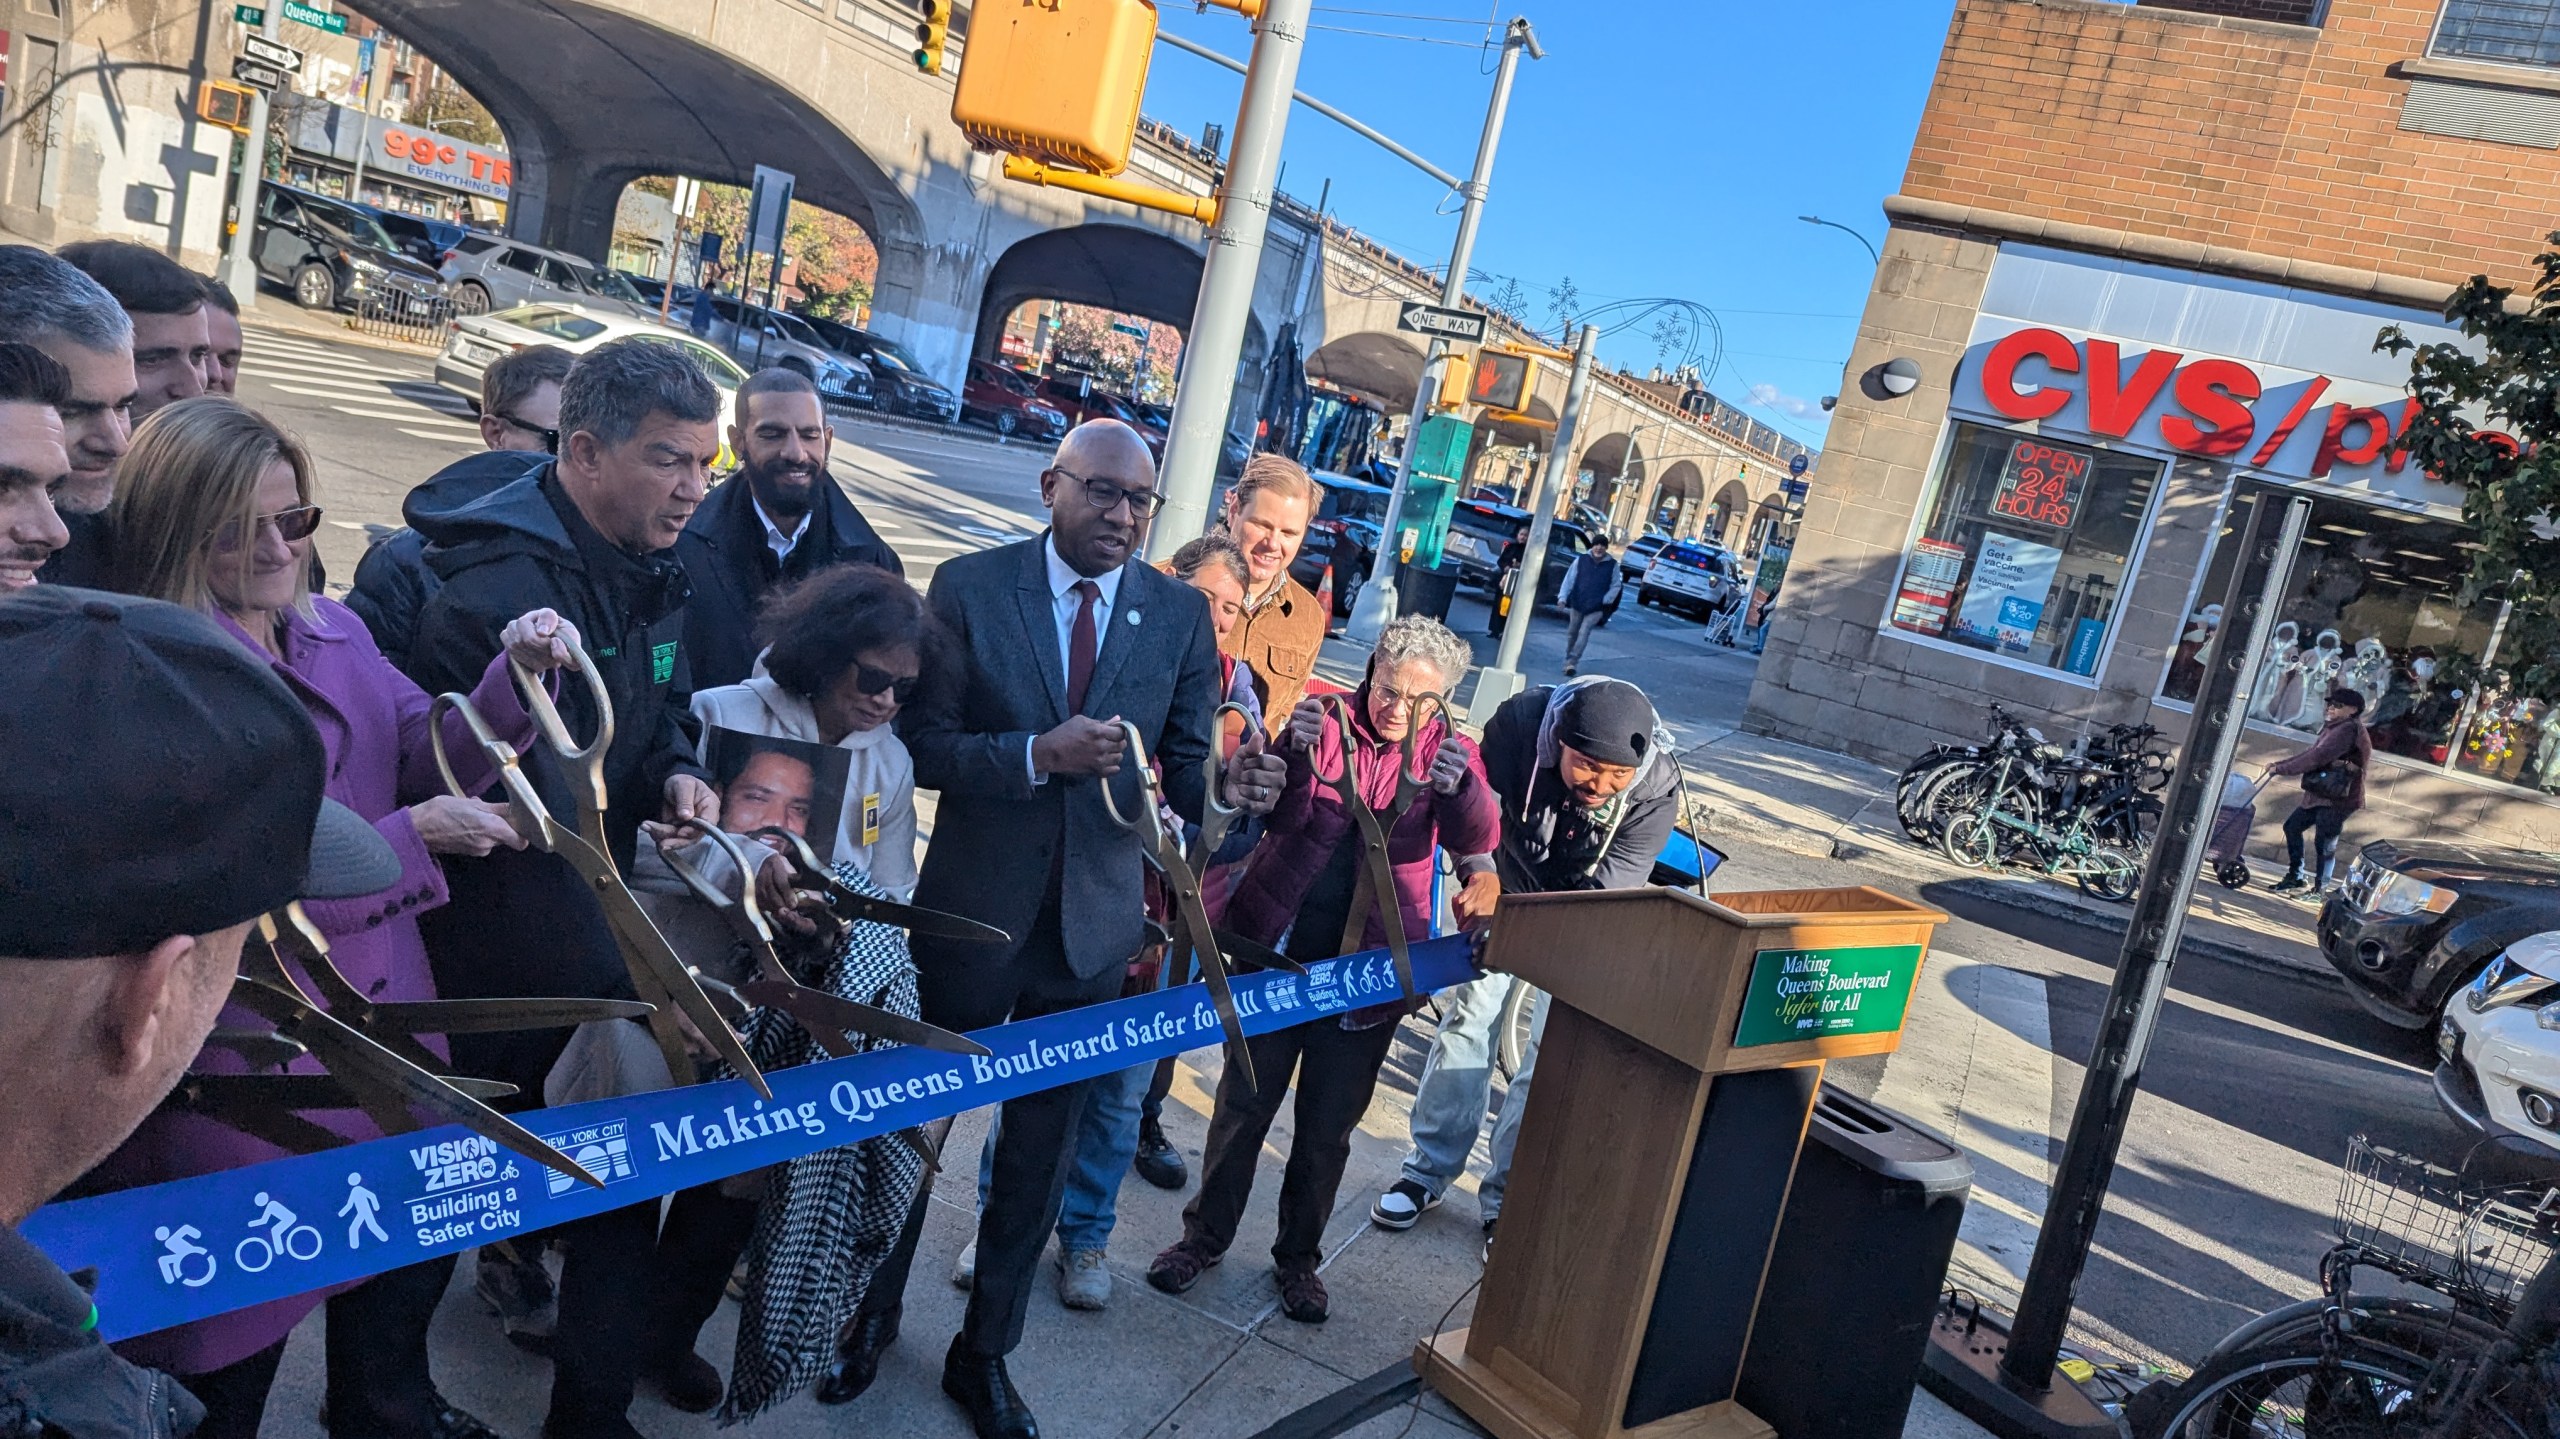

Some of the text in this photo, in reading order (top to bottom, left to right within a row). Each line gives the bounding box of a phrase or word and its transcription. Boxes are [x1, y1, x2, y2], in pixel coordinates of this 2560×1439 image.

[242, 8, 251, 22] 41
[285, 2, 342, 28] Queens Blvd
[252, 43, 295, 65] ONE WAY
[259, 69, 275, 81] WAY
[383, 128, 457, 165] 99¢
[407, 163, 491, 193] EVERYTHING
[1412, 312, 1475, 333] ONE WAY
[2015, 441, 2085, 476] OPEN
[2016, 467, 2066, 503] 24
[1997, 492, 2071, 525] HOURS
[1984, 558, 2026, 575] vaccine.
[1986, 548, 2013, 562] Get a
[2075, 628, 2095, 668] Healthier
[1310, 972, 1331, 987] ZERO
[1781, 954, 1832, 977] Making
[1308, 990, 1334, 1003] Building
[1777, 970, 1891, 998] Queens Boulevard
[1775, 993, 1819, 1025] Safer
[1820, 994, 1841, 1013] for
[1840, 992, 1862, 1011] All
[650, 1099, 826, 1162] Making
[829, 1068, 964, 1123] Queens
[970, 1021, 1120, 1085] Boulevard
[1123, 1011, 1187, 1047] Safer
[572, 1127, 599, 1145] YORK
[602, 1122, 625, 1137] CITY
[409, 1134, 498, 1170] VISION
[425, 1156, 497, 1192] ZERO
[411, 1187, 517, 1225] Building a
[416, 1209, 521, 1247] Safer City
